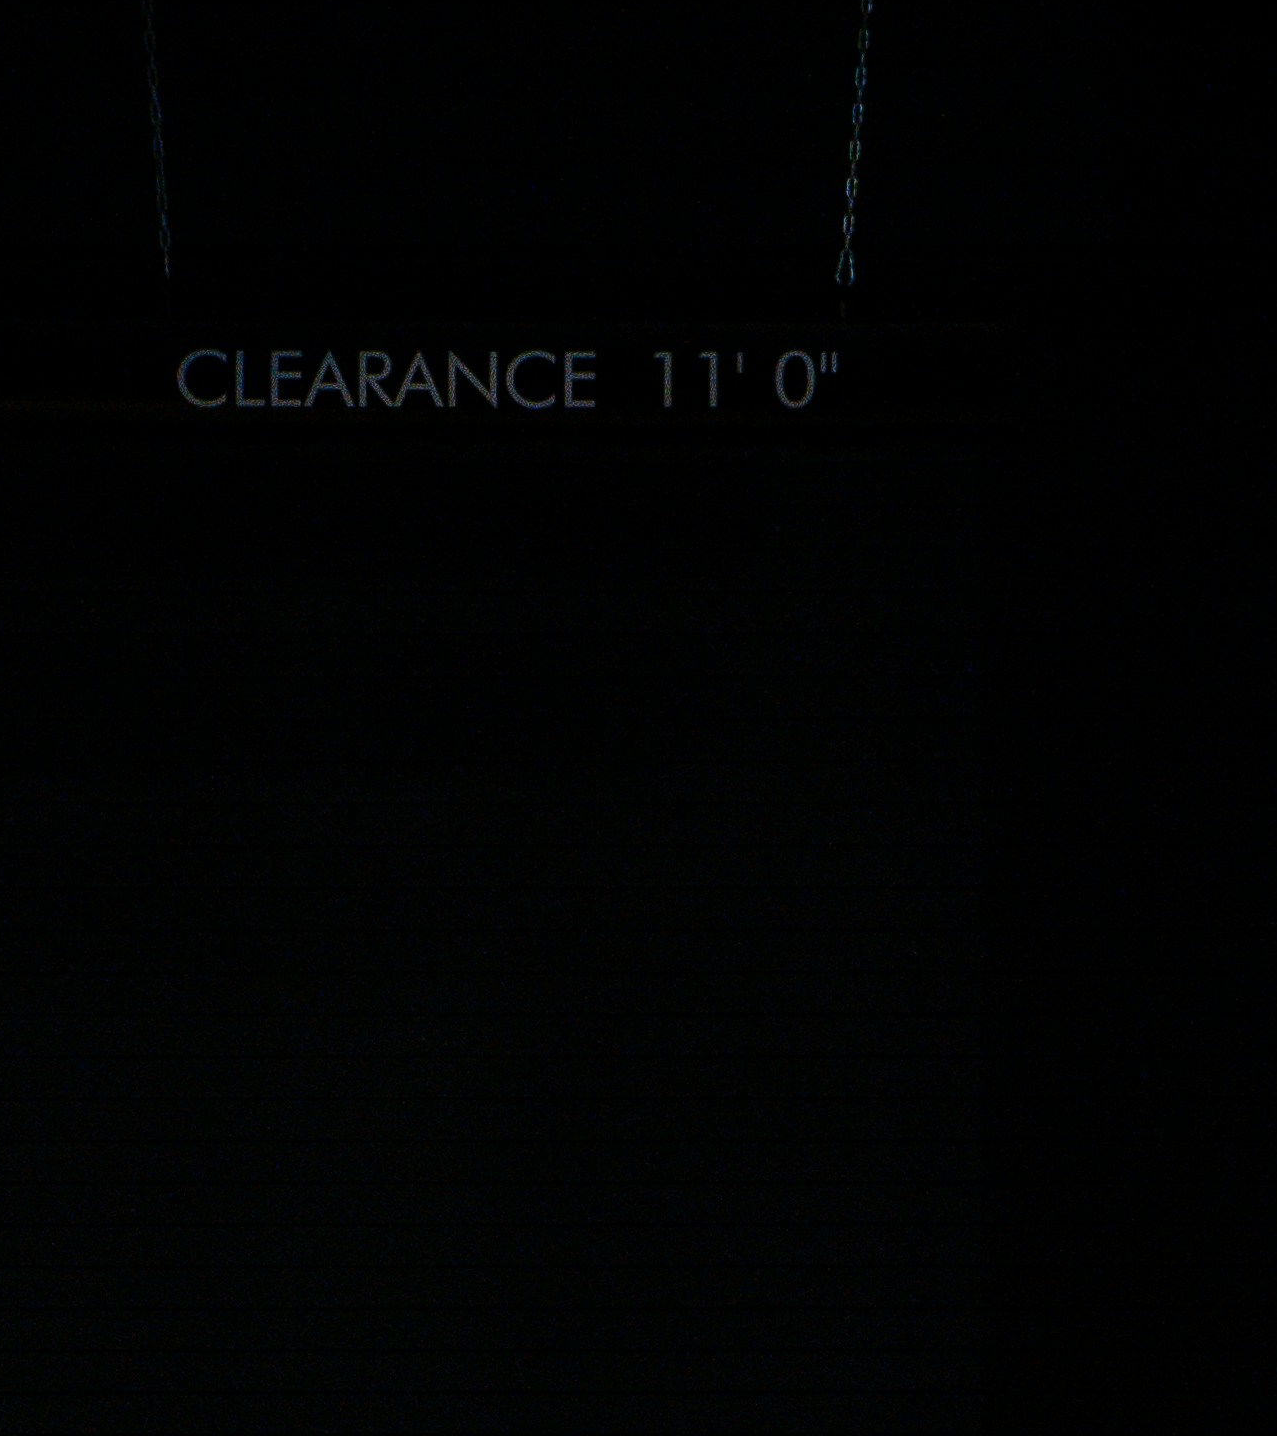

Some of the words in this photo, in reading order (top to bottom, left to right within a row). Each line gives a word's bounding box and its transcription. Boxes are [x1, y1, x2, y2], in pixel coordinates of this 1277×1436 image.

[176, 348, 597, 409] CLEARANCE
[653, 350, 744, 408] 11'
[774, 349, 838, 409] 0"
